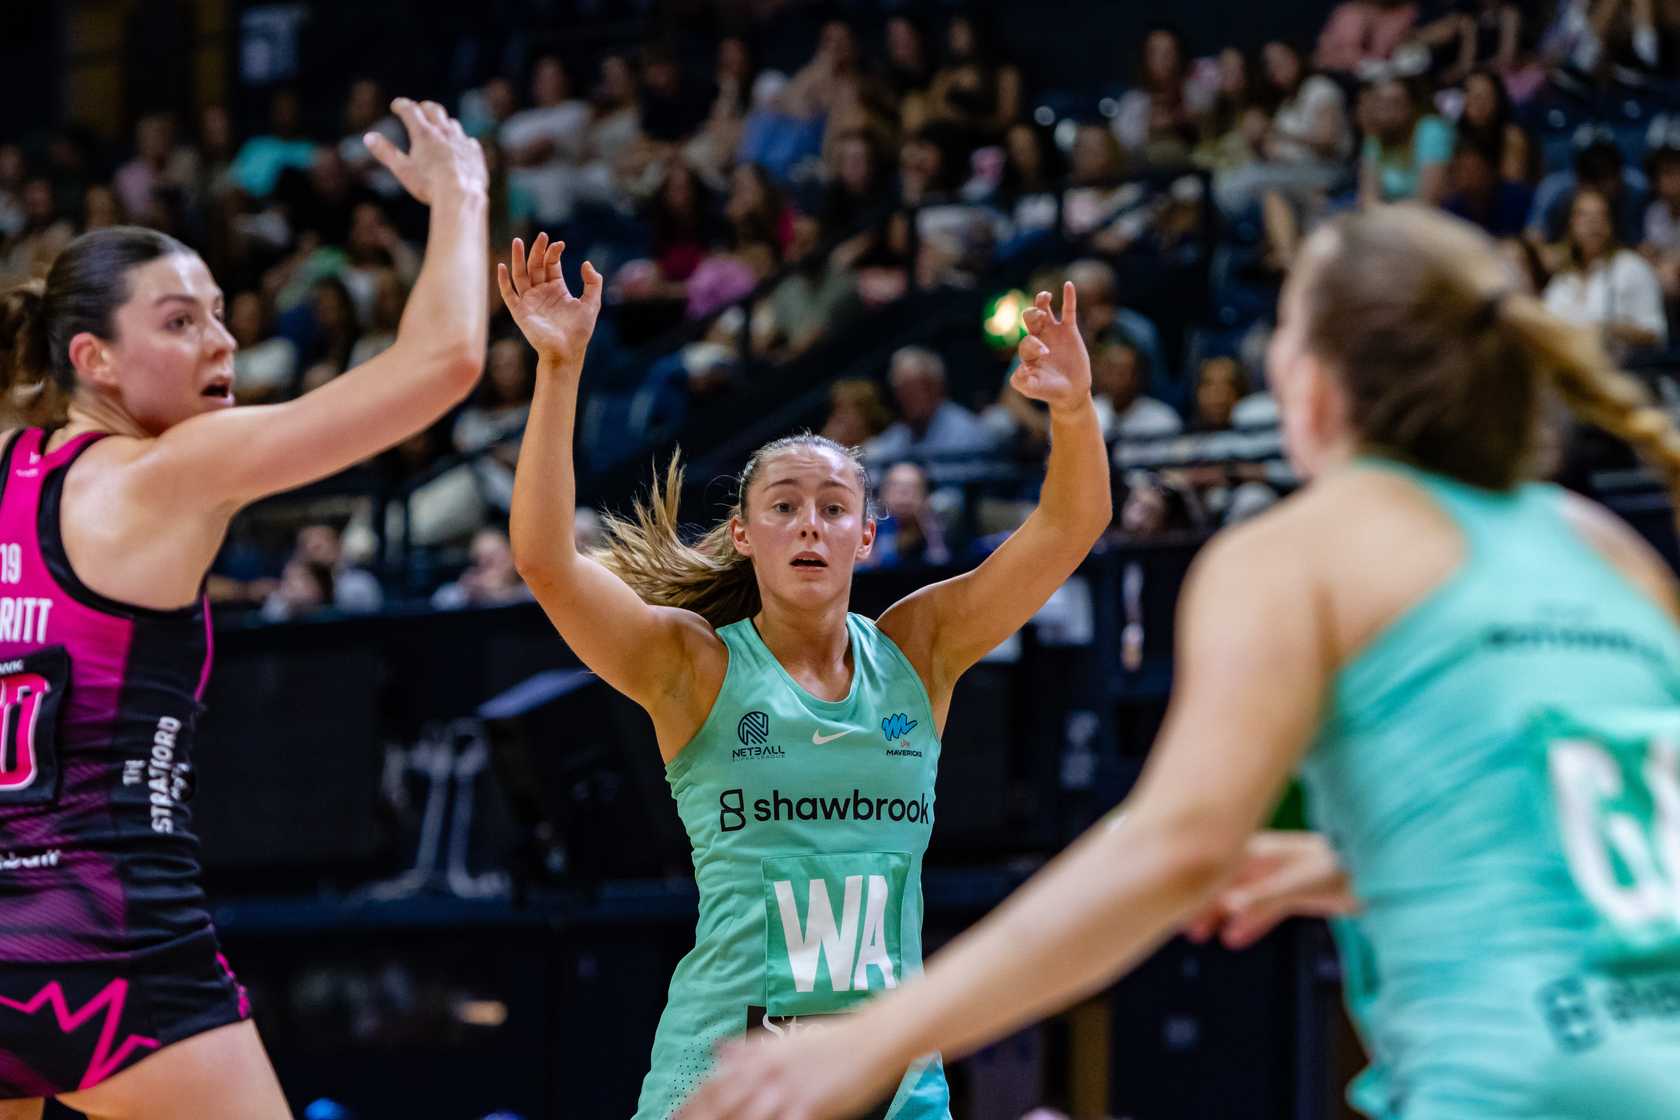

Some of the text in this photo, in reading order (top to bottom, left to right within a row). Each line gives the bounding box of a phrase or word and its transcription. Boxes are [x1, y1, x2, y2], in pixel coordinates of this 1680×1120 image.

[0, 543, 22, 584] 19
[732, 745, 785, 758] NETBALL
[122, 759, 145, 785] THE
[754, 789, 929, 825] shawbrook
[773, 874, 897, 993] WA
